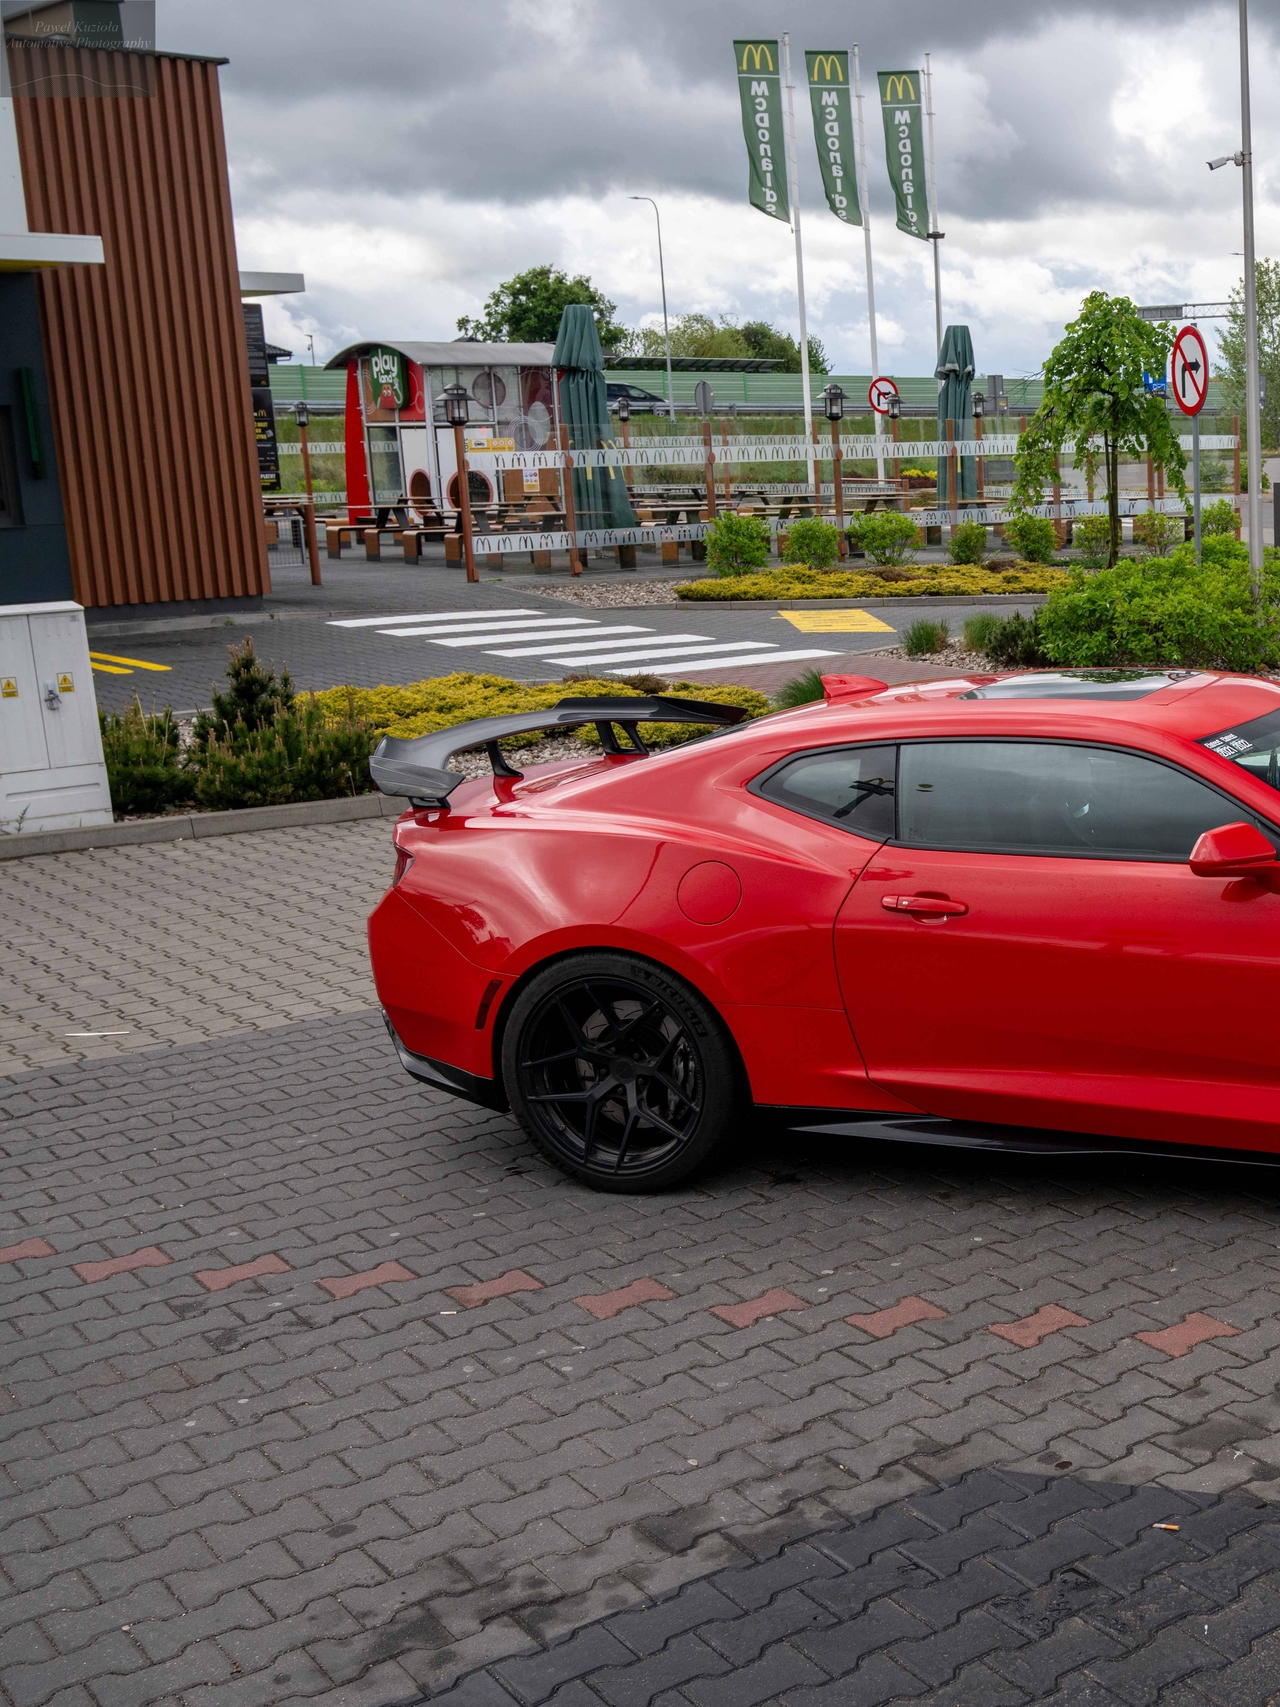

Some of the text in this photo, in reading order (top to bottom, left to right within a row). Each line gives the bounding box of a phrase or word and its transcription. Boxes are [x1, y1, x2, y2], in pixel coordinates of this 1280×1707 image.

[371, 348, 398, 379] play
[378, 371, 393, 383] land
[647, 974, 708, 1037] MICHELIN
